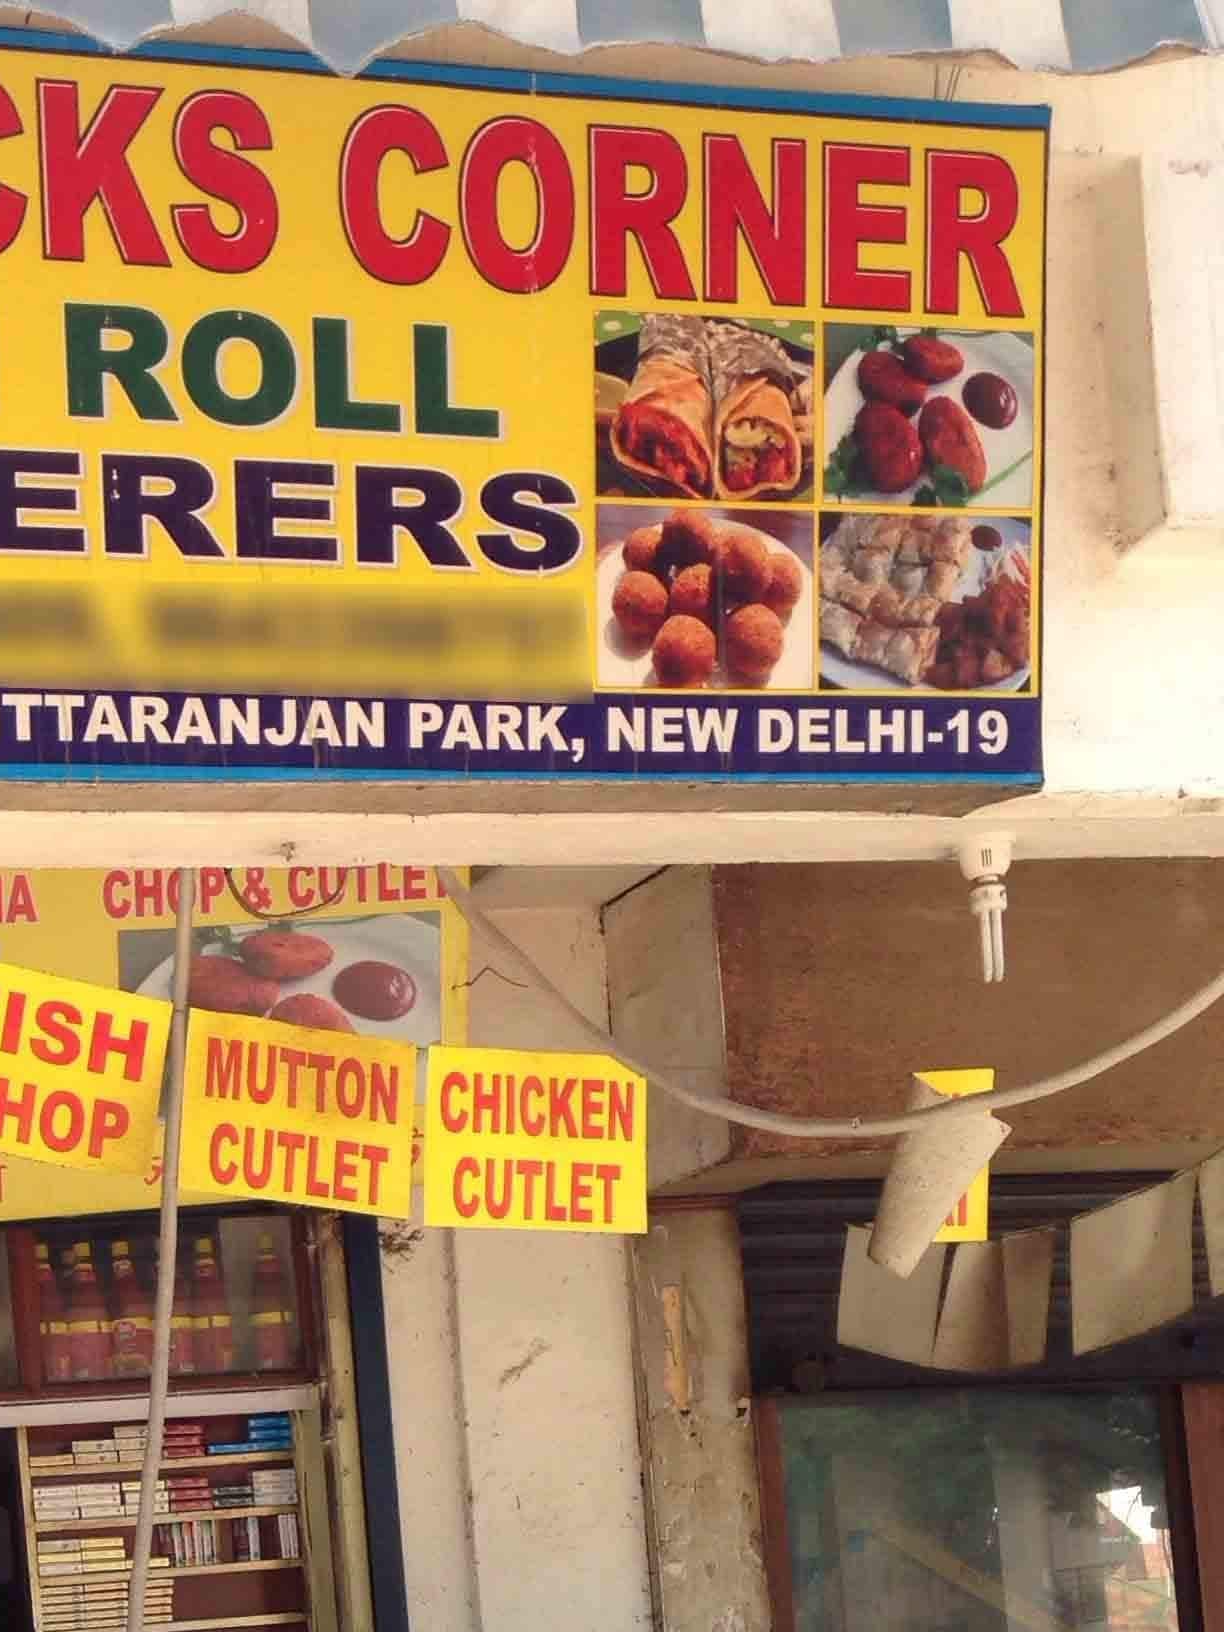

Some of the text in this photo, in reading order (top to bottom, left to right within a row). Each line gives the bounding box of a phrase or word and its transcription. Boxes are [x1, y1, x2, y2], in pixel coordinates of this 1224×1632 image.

[339, 103, 1025, 319] CORNER
[64, 302, 502, 440] ROLL
[410, 701, 585, 763] PARK,
[606, 706, 739, 754] NEW
[758, 707, 1008, 757] DELHI-19
[243, 866, 273, 911] &
[205, 1035, 401, 1125] MUTTON
[439, 1069, 634, 1143] CHICKEN
[209, 1122, 389, 1206] CUTLET
[451, 1154, 623, 1225] CUTLET
